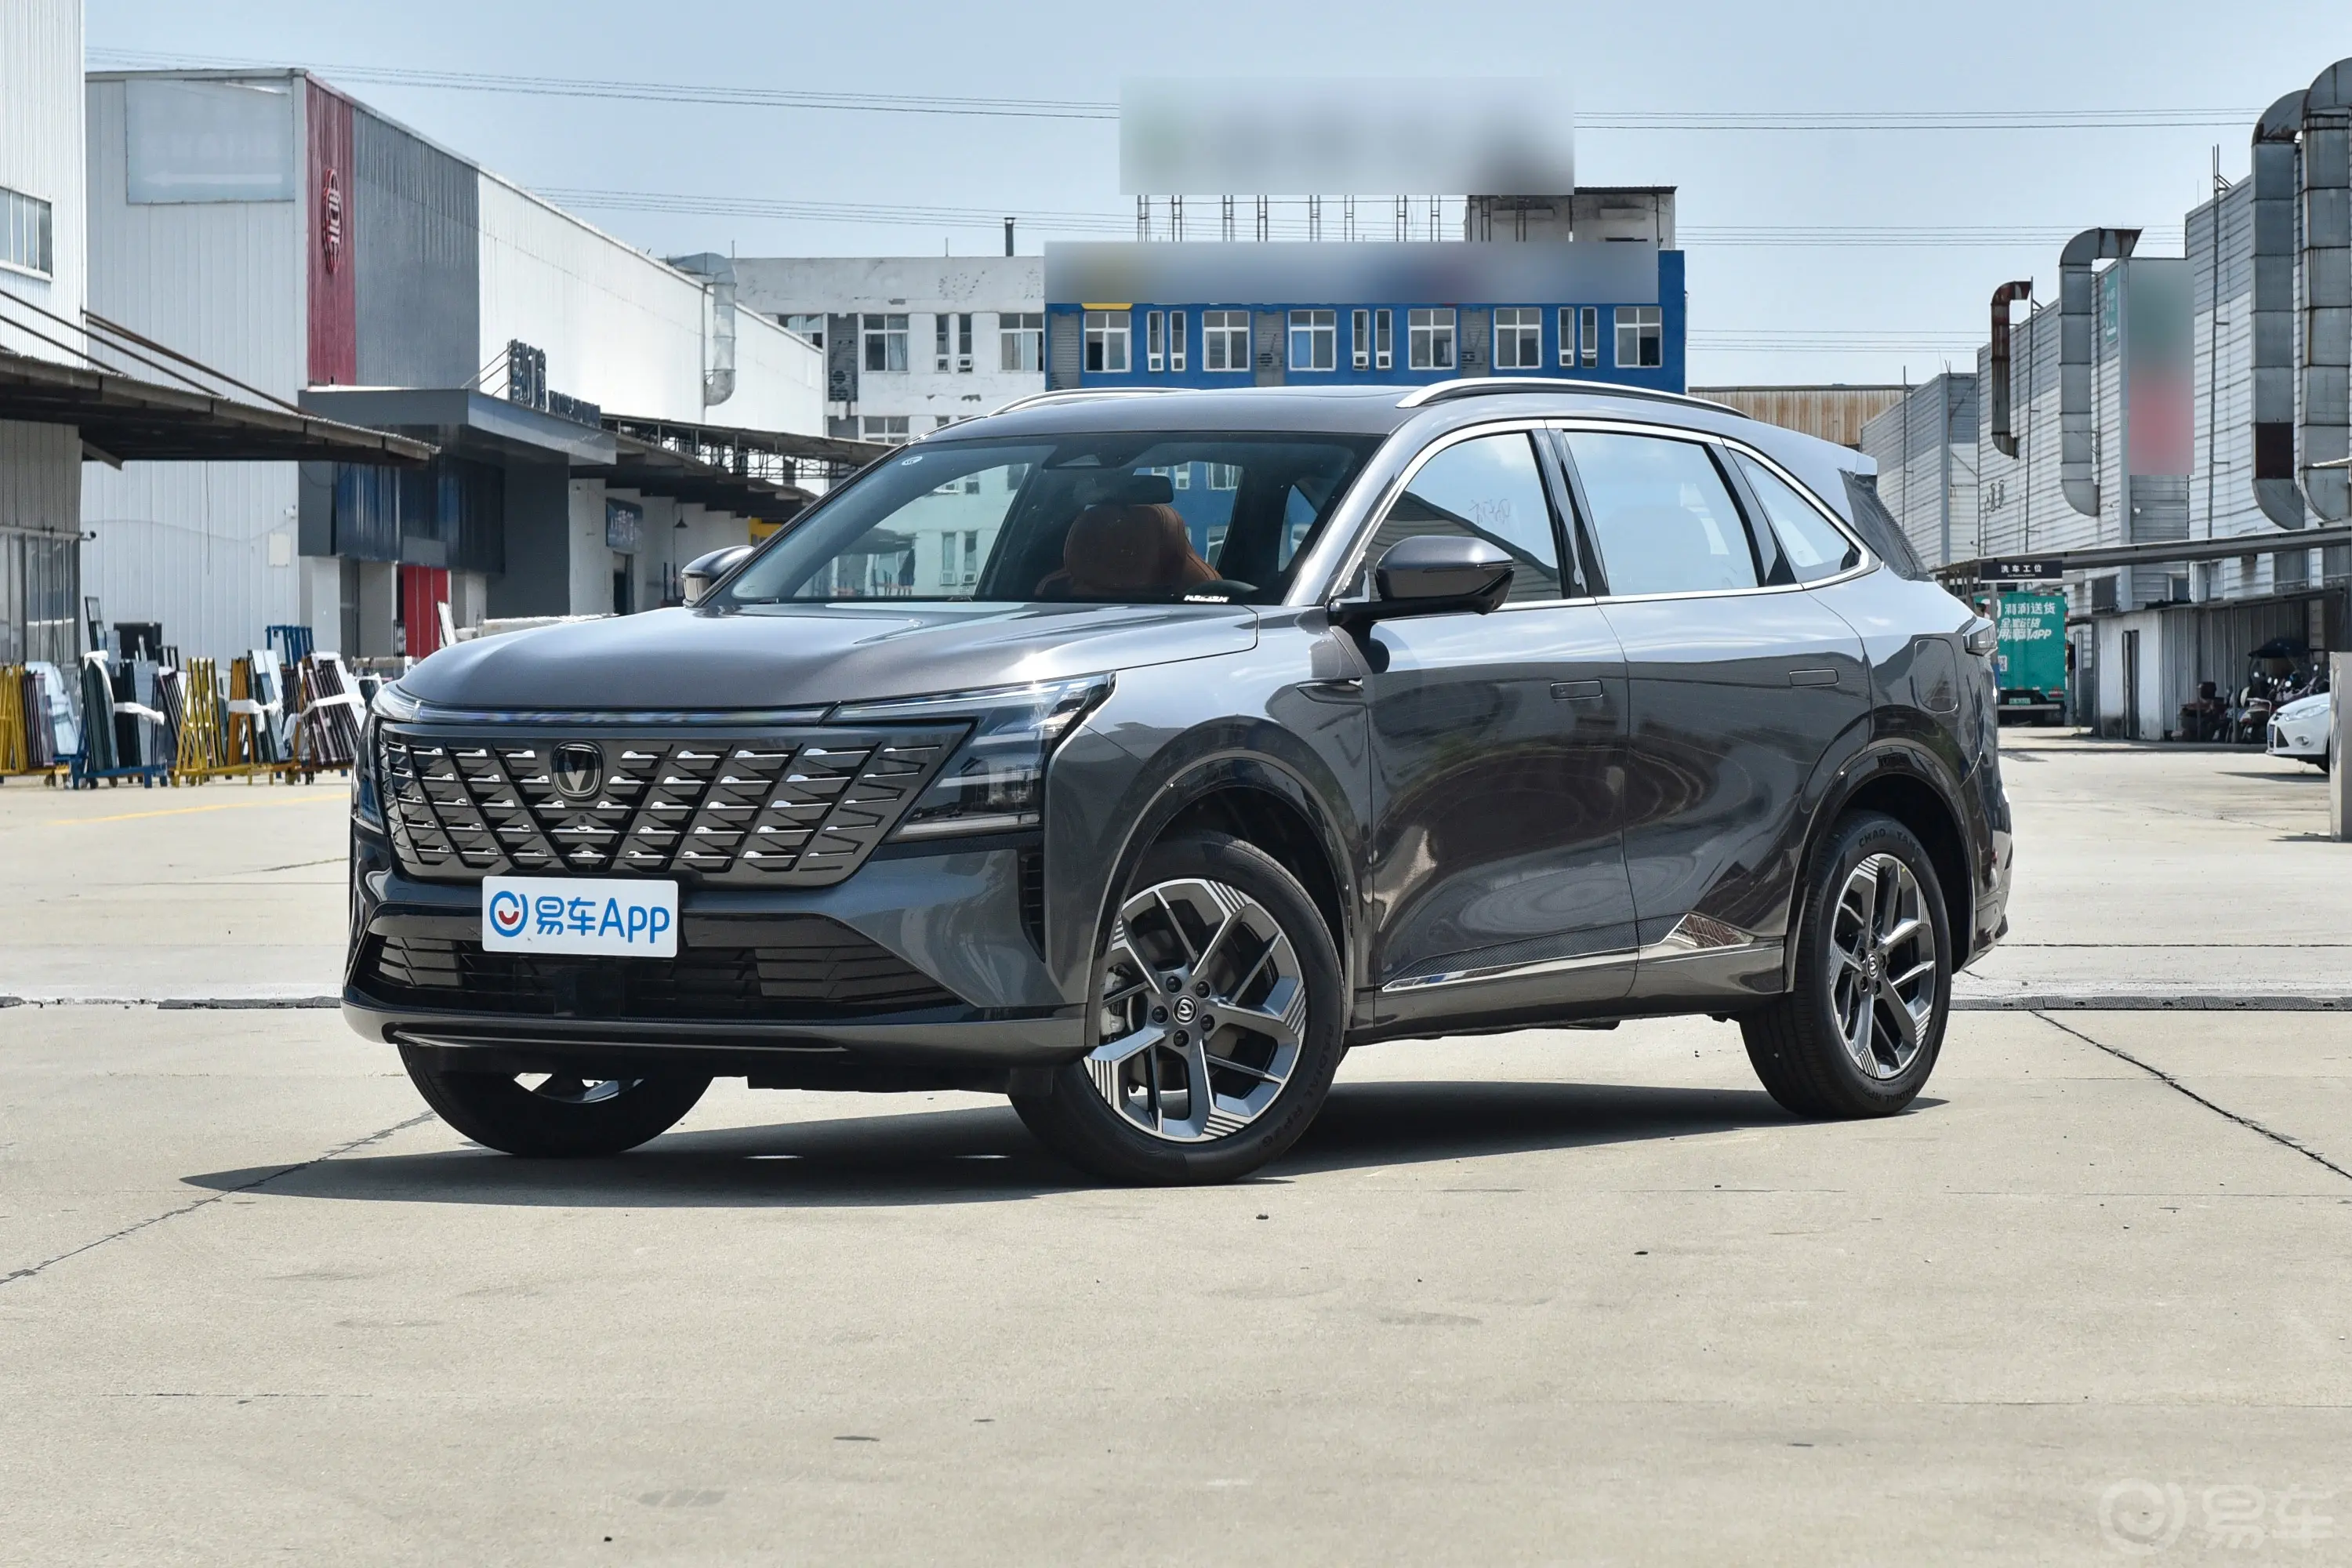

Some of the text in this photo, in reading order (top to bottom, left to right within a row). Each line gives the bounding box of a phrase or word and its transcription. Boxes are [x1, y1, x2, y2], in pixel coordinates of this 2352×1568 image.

[2001, 564, 2042, 573] 洗车工位
[2005, 602, 2055, 615] 滴滴送货
[1858, 828, 1886, 848] CHAO
[535, 895, 670, 944] 易车App
